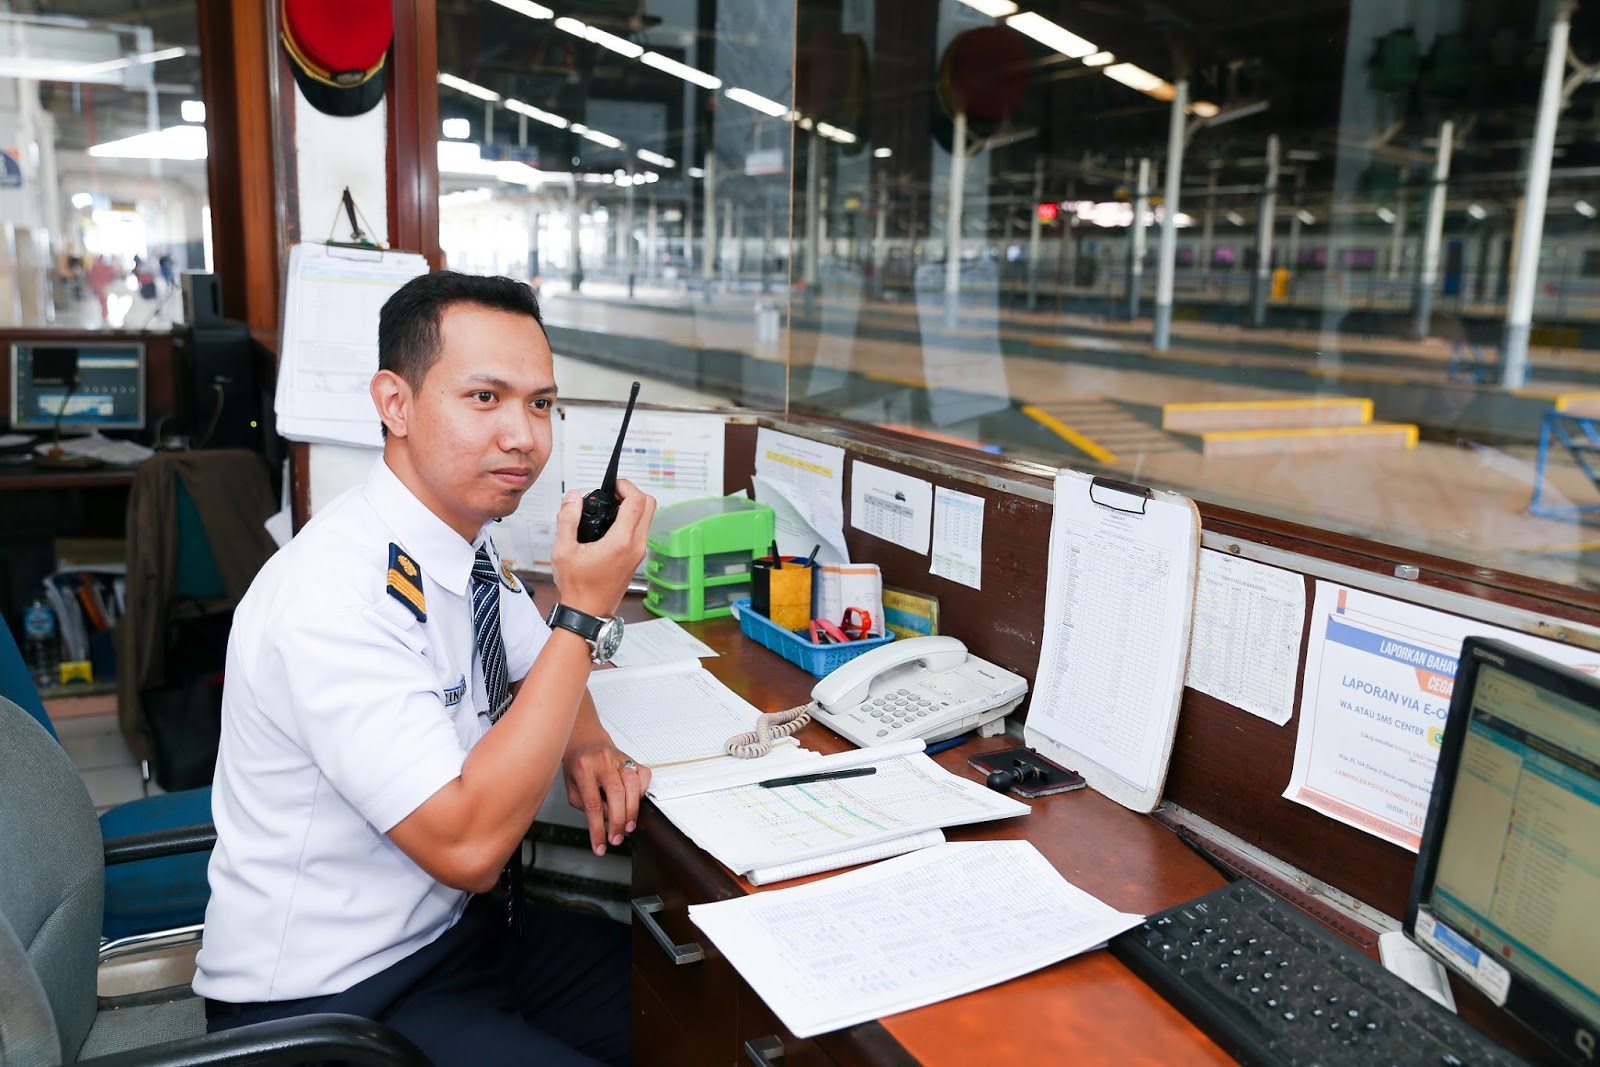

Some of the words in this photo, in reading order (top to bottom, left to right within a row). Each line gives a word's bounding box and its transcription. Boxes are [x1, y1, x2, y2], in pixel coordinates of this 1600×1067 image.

[1380, 640, 1427, 666] LAPORKAN
[1342, 675, 1399, 704] LAPORAN
[1401, 695, 1420, 711] VIA
[1423, 703, 1447, 720] E-O
[1340, 700, 1353, 711] WA
[1354, 706, 1375, 719] ATAU
[1376, 713, 1393, 725] SMS
[1394, 719, 1425, 736] CENTER
